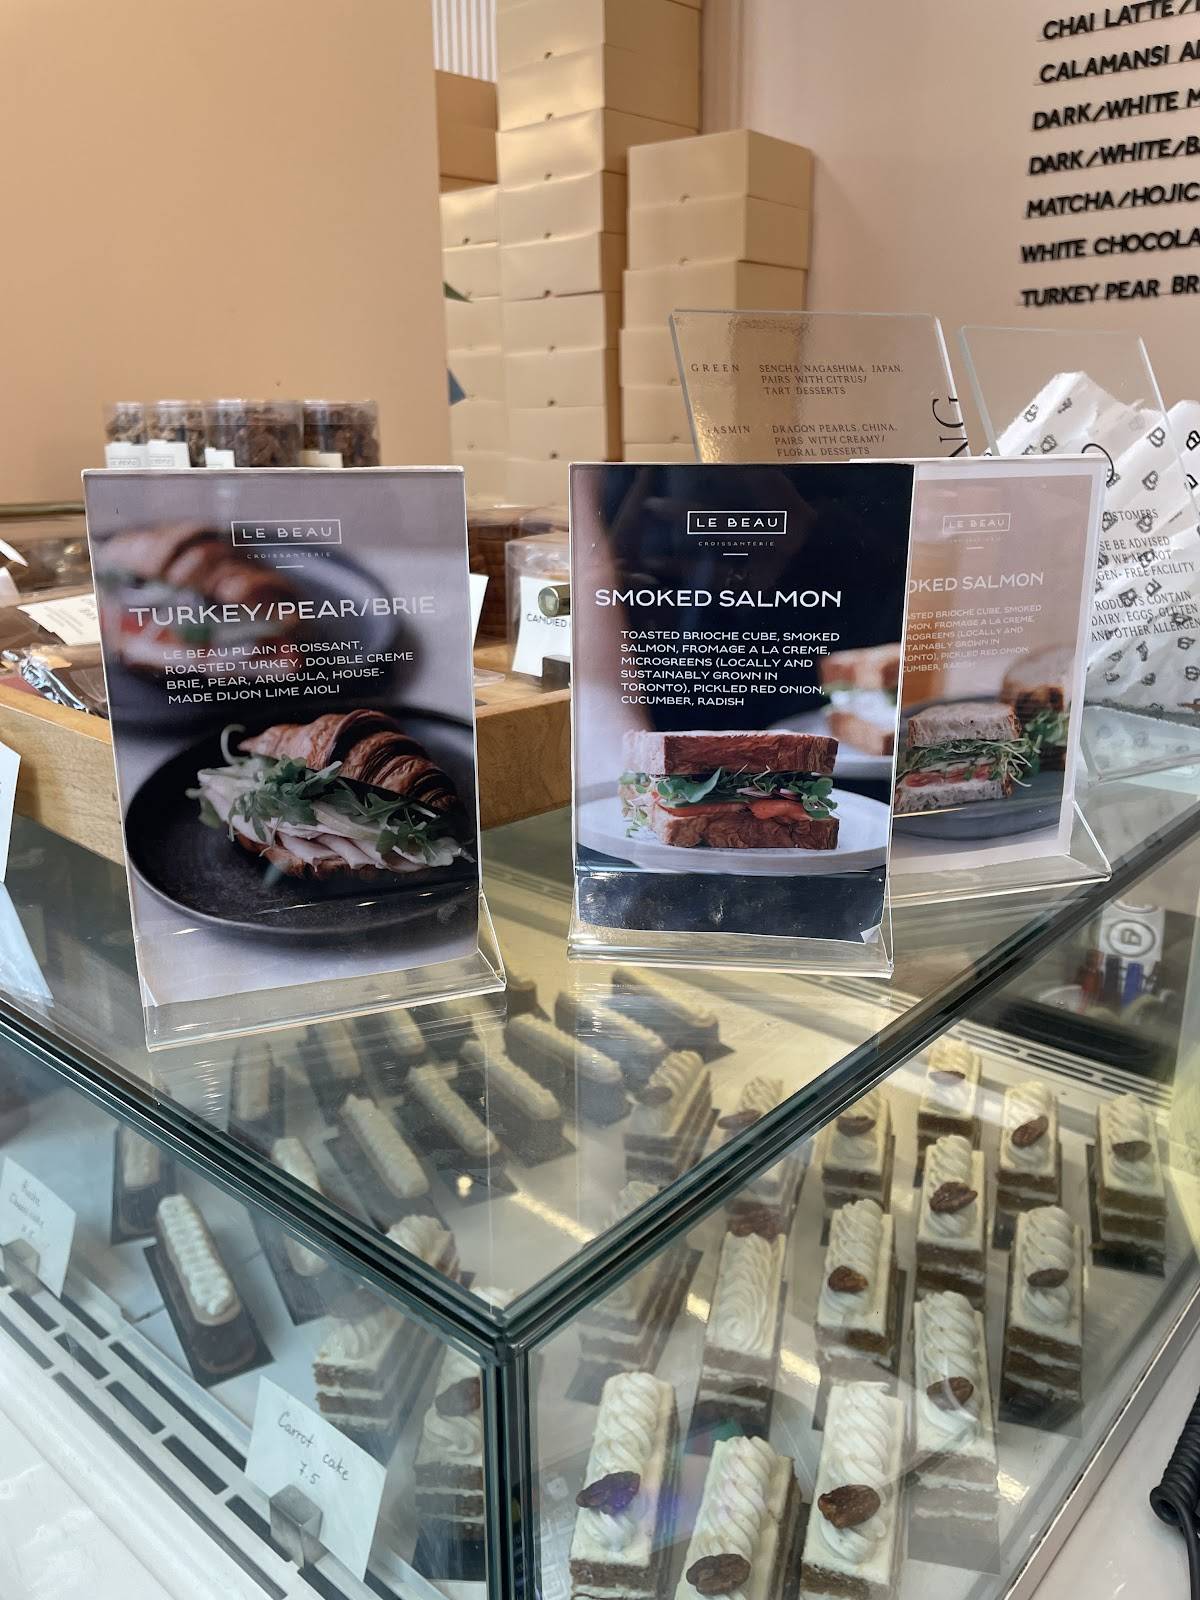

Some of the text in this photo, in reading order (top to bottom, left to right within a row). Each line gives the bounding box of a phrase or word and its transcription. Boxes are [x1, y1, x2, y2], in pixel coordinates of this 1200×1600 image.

[1043, 0, 1200, 40] CHAI LATTE/
[1040, 45, 1170, 83] CALAMANSI
[1033, 91, 1179, 131] DARK/WHITE
[1021, 238, 1086, 264] WHITE
[1021, 284, 1099, 308] TURKEY
[1105, 279, 1160, 301] PEAR
[690, 363, 740, 373] GREEN
[761, 375, 791, 384] PAIRS
[795, 375, 824, 384] WITH
[763, 386, 847, 395] TART DESSERTS
[771, 424, 816, 434] DRAGON
[774, 436, 804, 446] PAIRS
[808, 435, 838, 445] WITH
[776, 446, 871, 457] FLORAL DESSERTS
[696, 517, 778, 528] LE BEAU
[970, 519, 1004, 529] BEAU
[242, 527, 332, 539] LE BEAU
[1114, 539, 1127, 550] BE
[1129, 536, 1170, 549] ADVISED
[1124, 565, 1150, 579] FREE
[1151, 561, 1196, 577] FACILITY
[962, 571, 1044, 591] SALMON
[595, 589, 842, 608] SMOKED SALMON
[1147, 591, 1192, 606] CONTAIN
[129, 596, 436, 627] TURKEY/PEAR/BRIE
[935, 607, 975, 618] BRIOCHE
[1003, 604, 1042, 614] SMOKED
[934, 619, 980, 629] FROMAGE
[1003, 626, 1024, 635] AND
[620, 630, 841, 642] TOASTED BRIOCHE CUBE, SMOKED
[1114, 623, 1150, 641] OTHER
[163, 640, 364, 660] LE BEAU PLAIN CROISSANT,
[620, 643, 831, 656] SALMON, FROMAGE A LA CREME,
[164, 652, 414, 675] ROASTED TURKEY, DOUBLE CREME
[621, 657, 814, 668] MICROGREENS (LOCALLY AND
[166, 668, 385, 690] BRIE, PEAR, ARUGULA, HOUSE-
[620, 670, 778, 680] SUSTAINABLY GROWN IN
[168, 684, 340, 705] MADE DIJON LIME AIOLI
[620, 682, 825, 696] TORONTO), PICKLED RED ONION,
[621, 695, 745, 706] CUCUMBER, RADISH
[278, 1411, 350, 1481] Carrot cake
